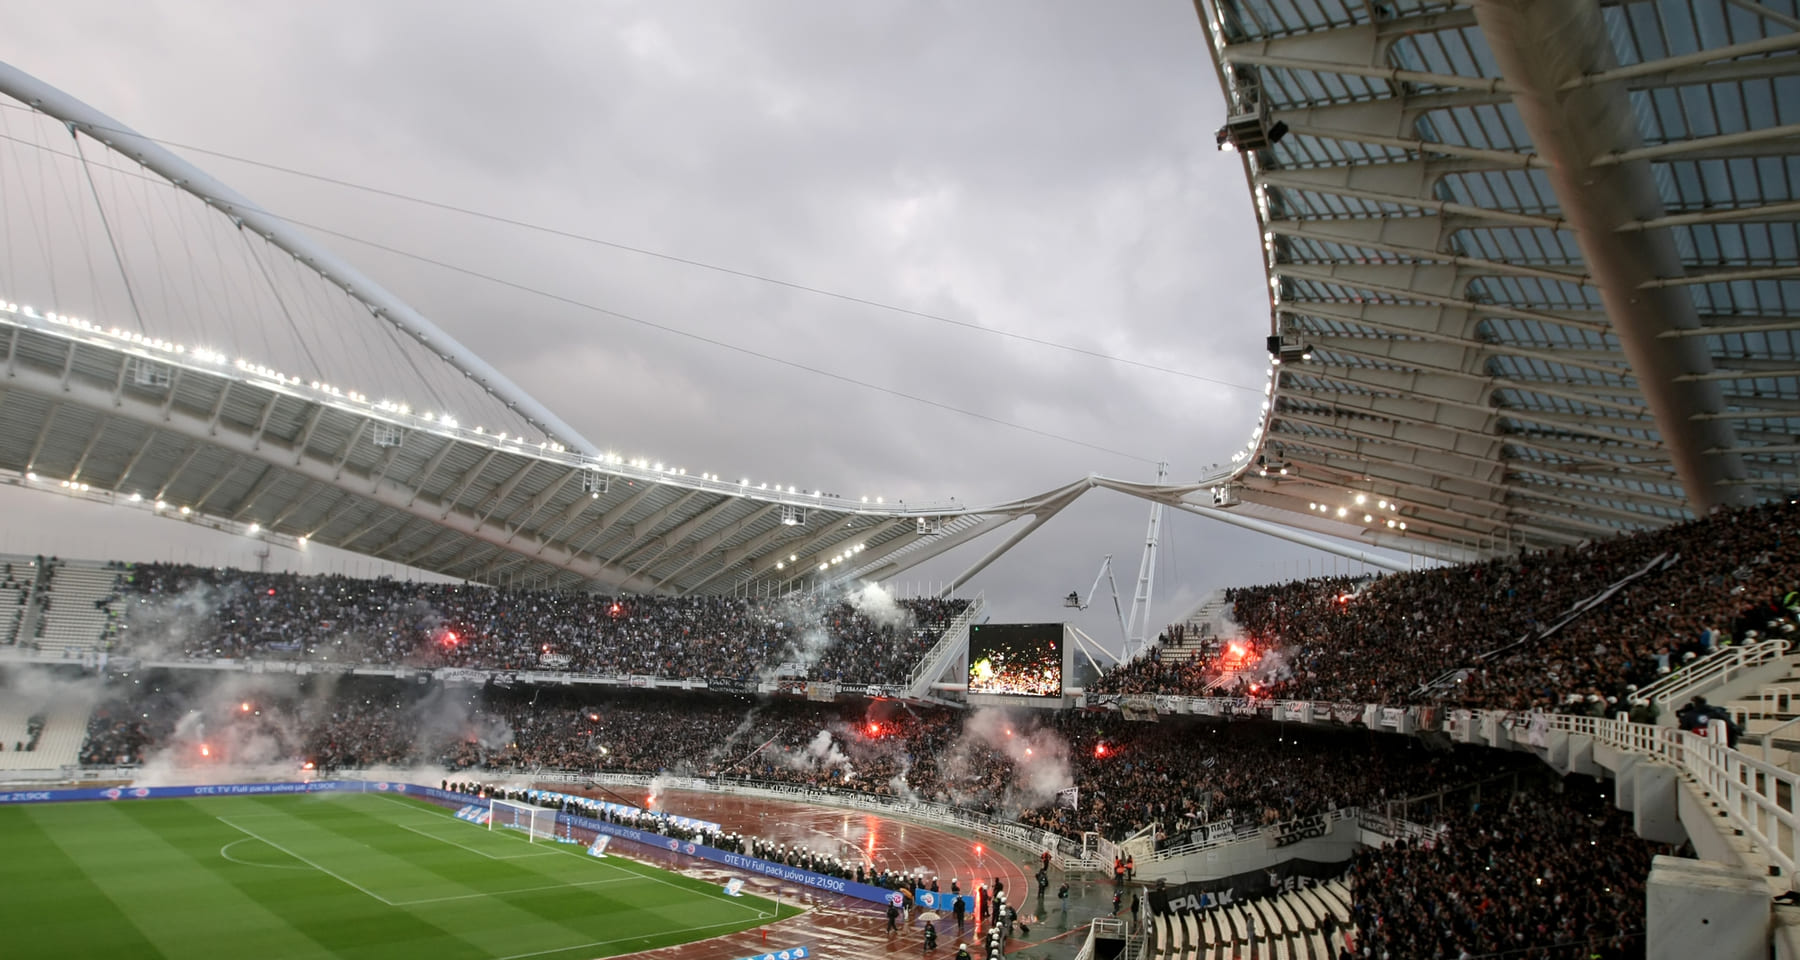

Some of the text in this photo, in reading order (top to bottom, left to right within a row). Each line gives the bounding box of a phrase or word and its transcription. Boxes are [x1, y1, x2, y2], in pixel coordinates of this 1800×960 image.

[194, 786, 215, 794] OTE
[232, 785, 248, 793] Full
[249, 785, 271, 793] pack
[724, 854, 845, 892] OTE TV Full pack μόνο με 21,90€
